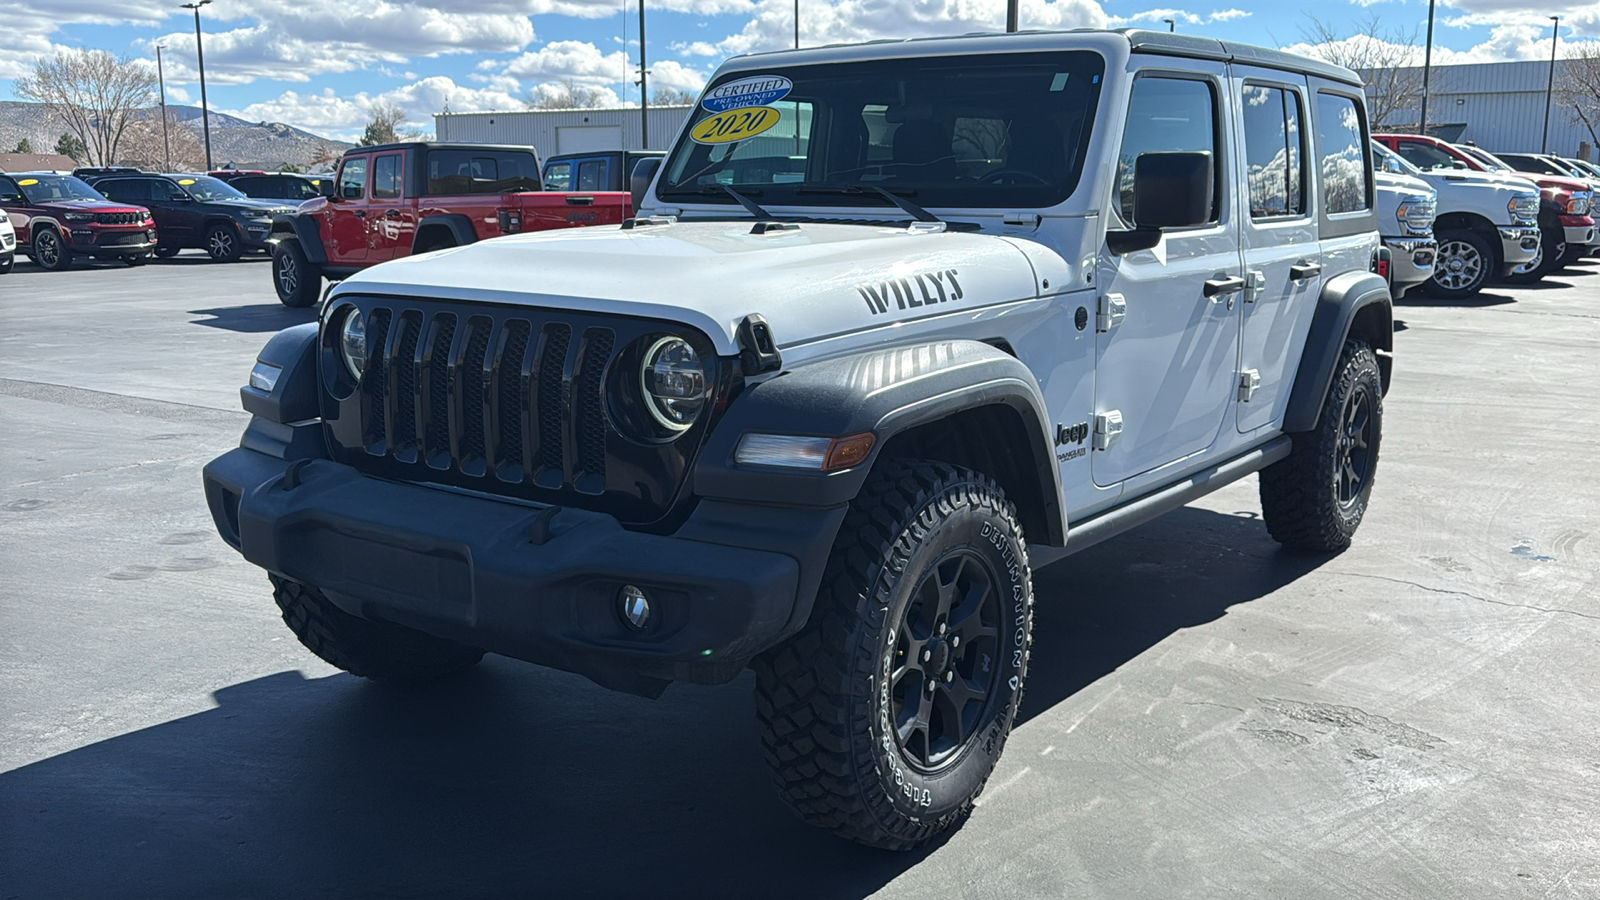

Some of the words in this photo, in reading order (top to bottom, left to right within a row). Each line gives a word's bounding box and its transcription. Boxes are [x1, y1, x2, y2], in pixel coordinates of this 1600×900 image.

[714, 80, 784, 98] CERTIFIED
[713, 91, 777, 106] PRE-OWNED
[721, 98, 766, 110] VEHICLE
[700, 109, 768, 139] 2020
[565, 210, 597, 225] Jeep
[854, 268, 963, 315] WILLYS
[1054, 421, 1088, 448] Jeep
[1056, 447, 1087, 460] RANGLER
[980, 520, 1026, 668] DESTINATION
